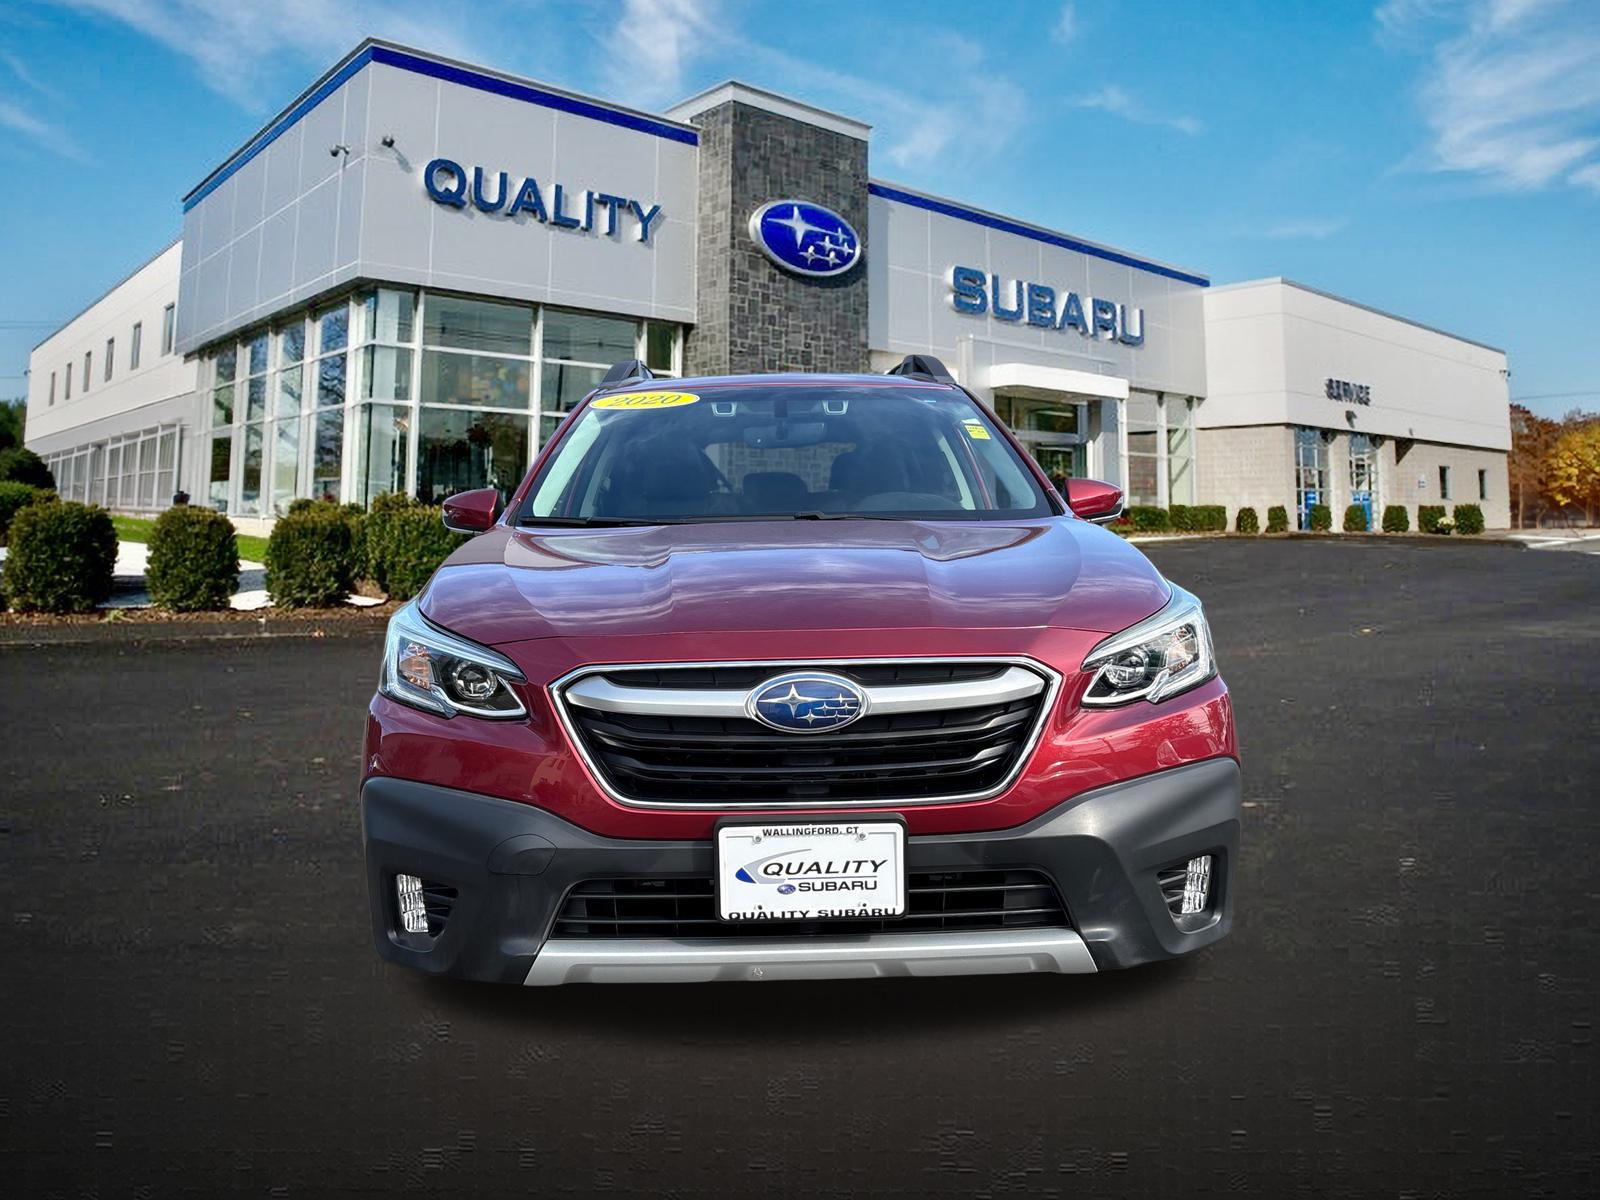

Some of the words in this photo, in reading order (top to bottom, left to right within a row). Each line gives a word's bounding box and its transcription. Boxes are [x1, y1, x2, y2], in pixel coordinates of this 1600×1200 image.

[424, 158, 661, 242] QUALITY
[951, 265, 1145, 347] SUBARU
[1325, 378, 1371, 406] SERVICE
[607, 394, 682, 407] 2020
[845, 826, 860, 835] CT
[763, 859, 888, 876] QUALITY
[798, 880, 878, 892] SUBARU
[728, 910, 810, 920] QUALITY
[817, 907, 897, 918] SUBARU
